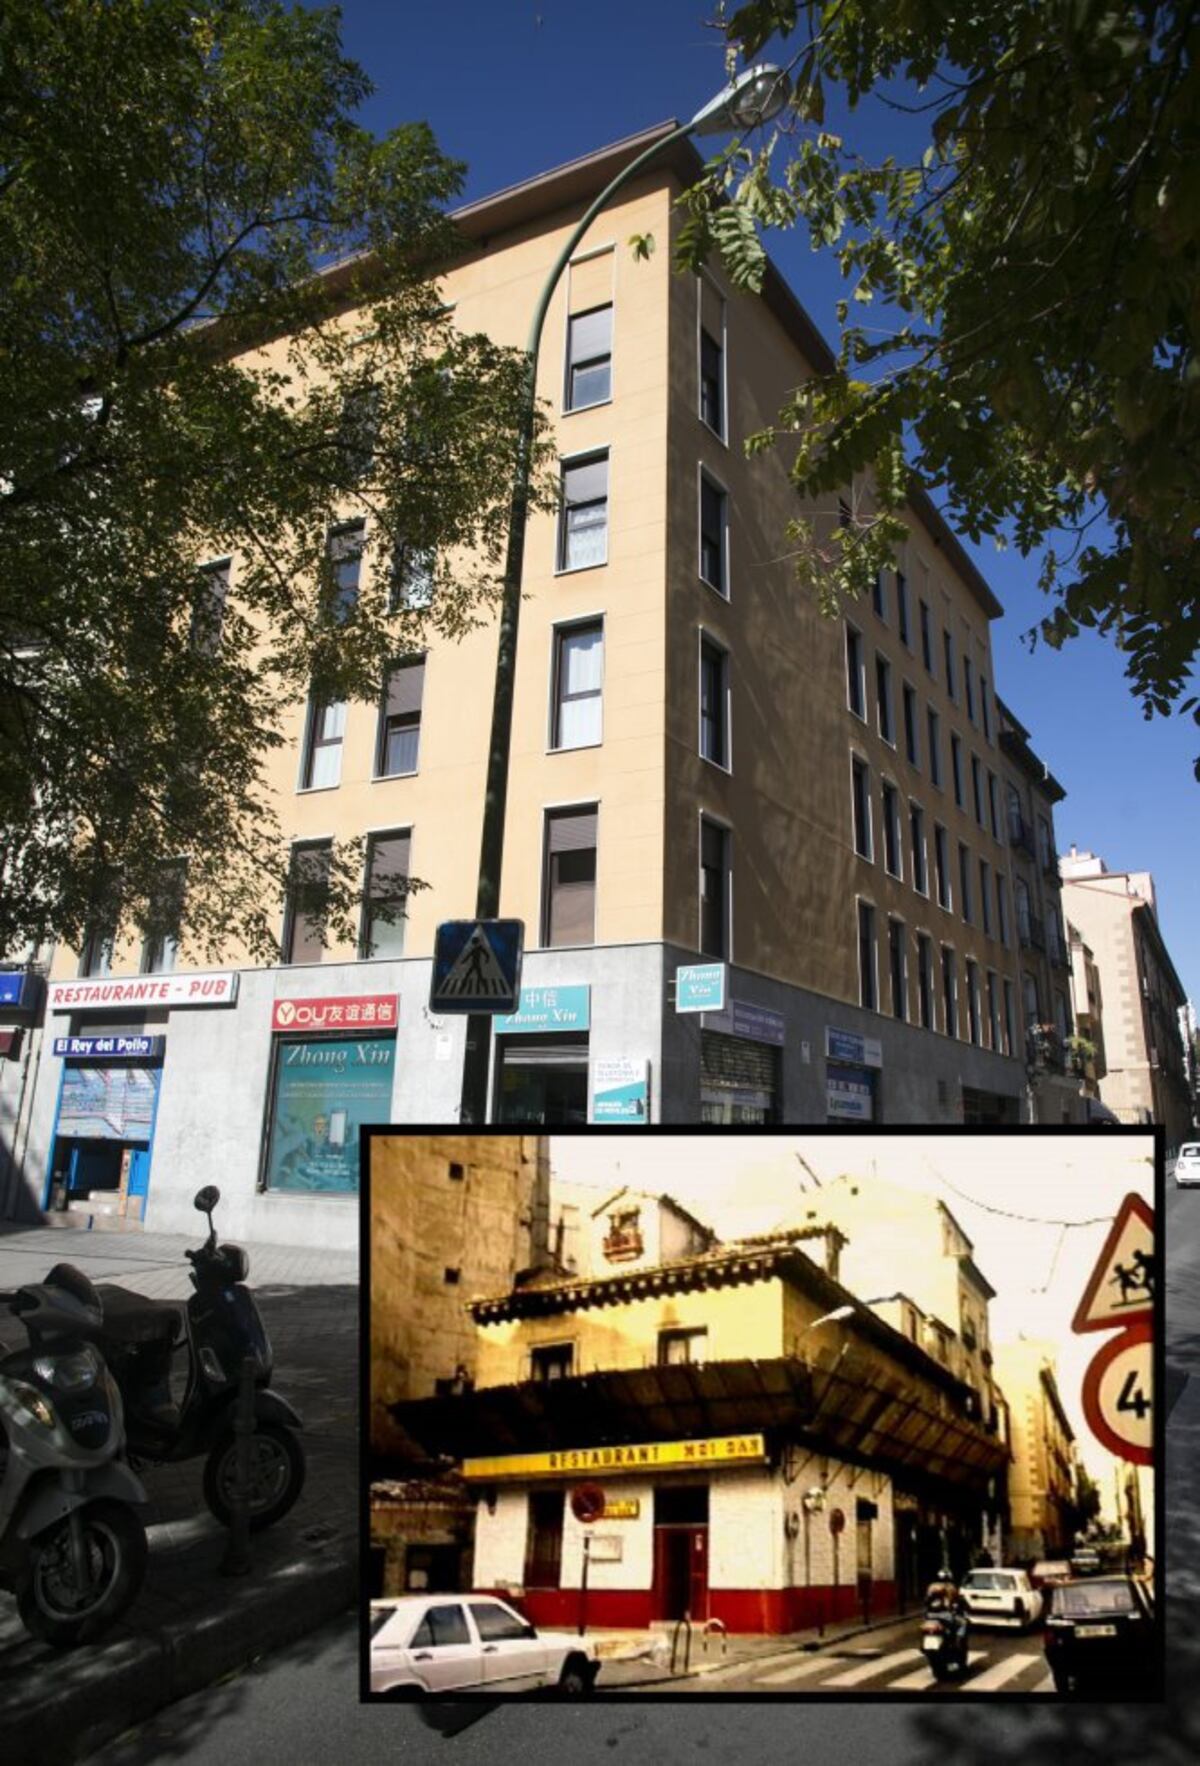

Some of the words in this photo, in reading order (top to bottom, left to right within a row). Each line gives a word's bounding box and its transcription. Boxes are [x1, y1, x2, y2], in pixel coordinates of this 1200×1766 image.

[53, 983, 170, 1004] RESTAURANTE
[188, 979, 228, 996] PUB
[552, 1008, 577, 1023] Xin
[56, 1040, 68, 1052] El
[70, 1038, 92, 1054] Rey
[95, 1037, 114, 1052] del
[117, 1036, 149, 1051] Pollo
[356, 1042, 391, 1064] Xin
[1116, 1371, 1150, 1419] 4
[549, 1446, 660, 1468] RESTAURANT
